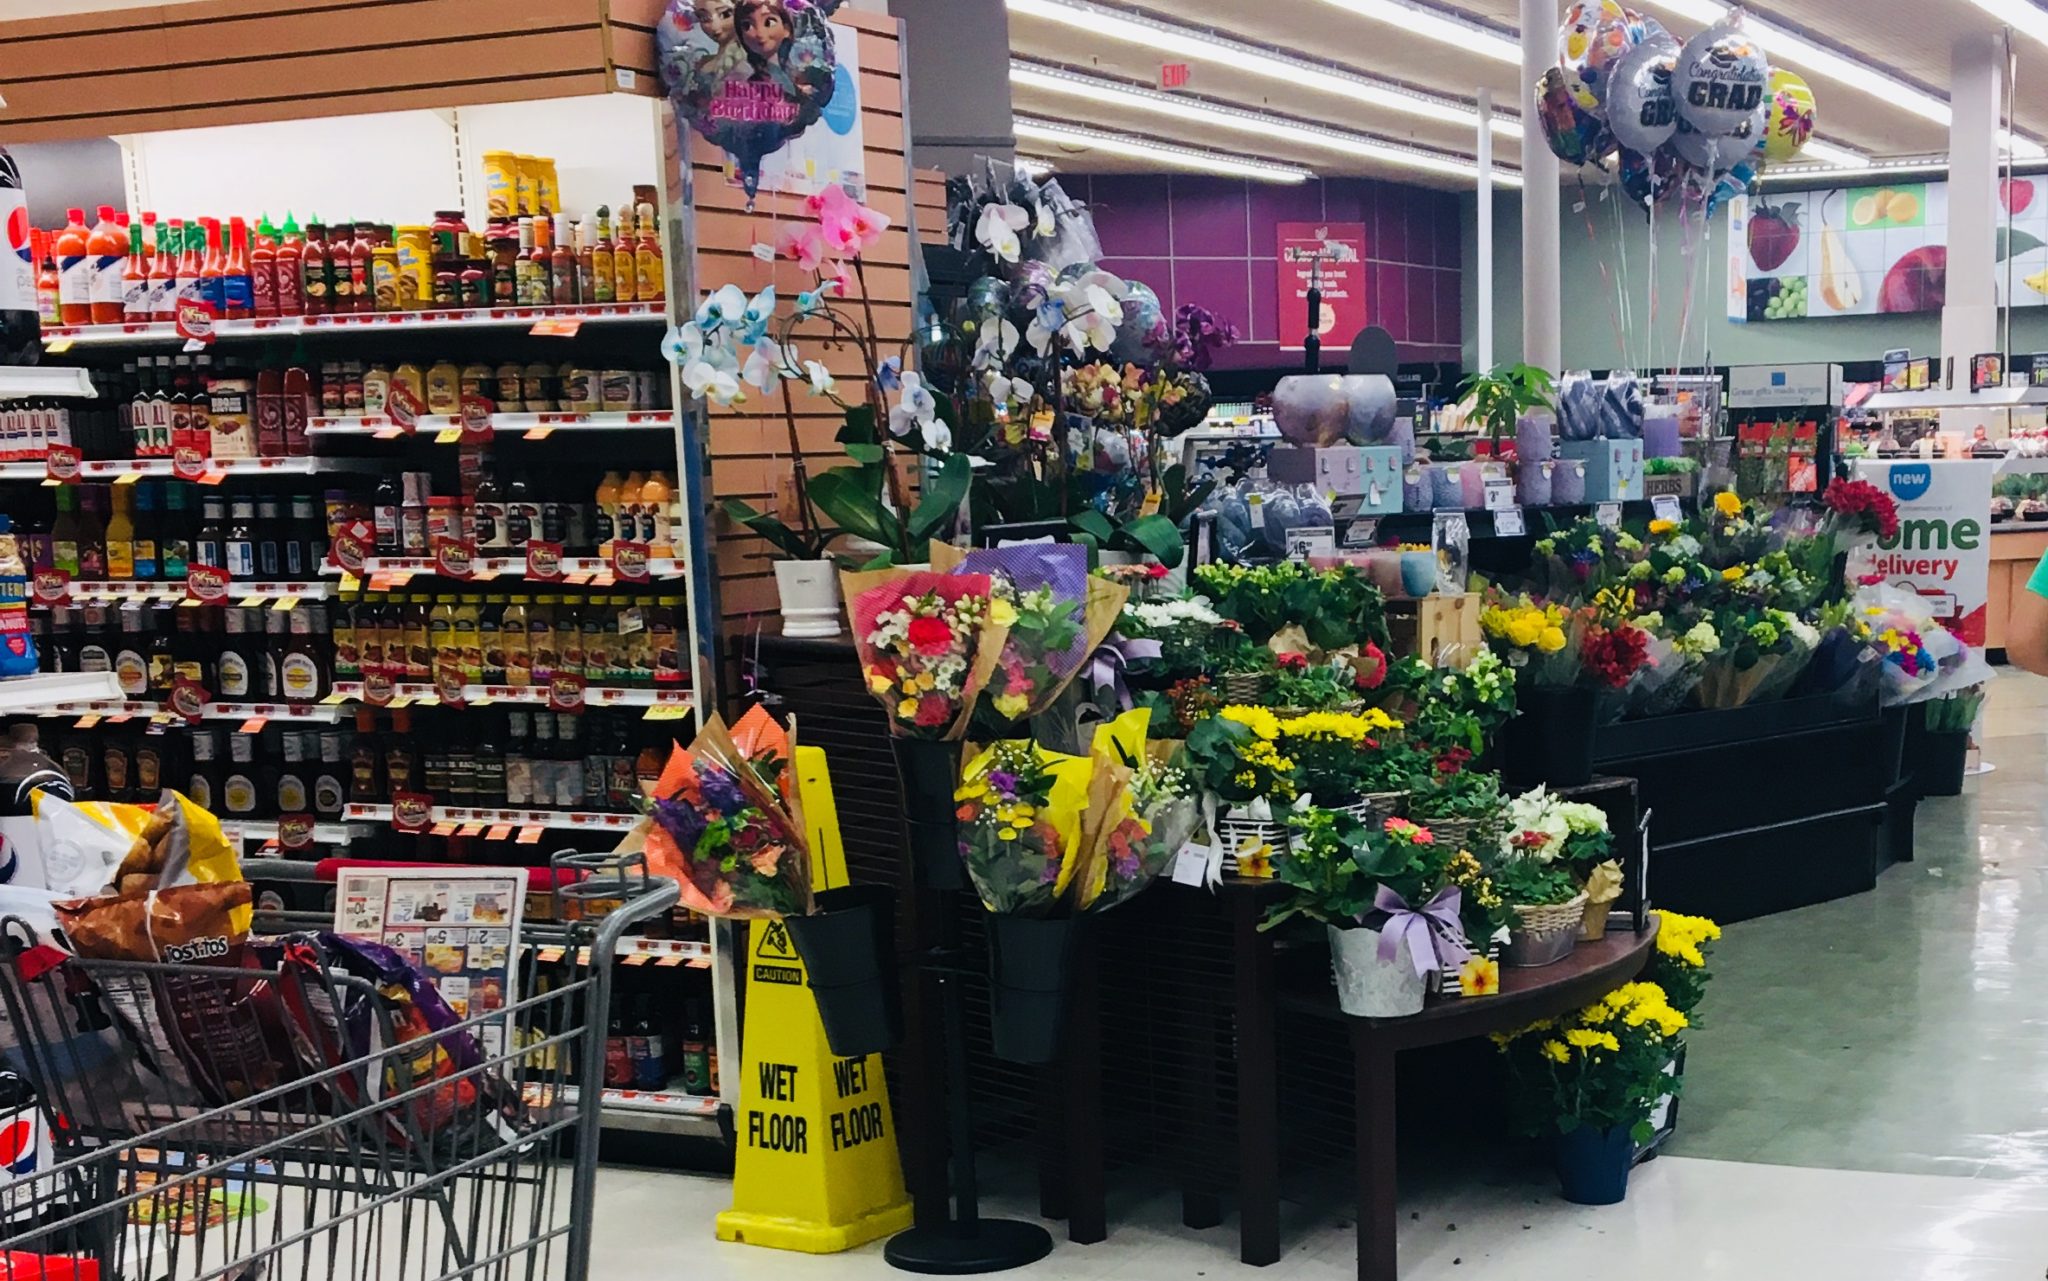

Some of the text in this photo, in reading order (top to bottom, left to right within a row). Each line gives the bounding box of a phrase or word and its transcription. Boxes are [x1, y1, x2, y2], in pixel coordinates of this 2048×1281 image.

[724, 80, 784, 102] Happy
[1687, 81, 1763, 111] GRAD
[1640, 99, 1676, 127] GR
[1646, 479, 1682, 496] HERBS
[1893, 473, 1926, 485] new
[1867, 519, 1981, 550] ome
[1869, 554, 1958, 581] elivery
[756, 967, 800, 983] CAUTION
[759, 1062, 798, 1102] WET
[833, 1054, 868, 1098] WET
[749, 1110, 807, 1154] FLOOR
[831, 1102, 884, 1151] FLOOR
